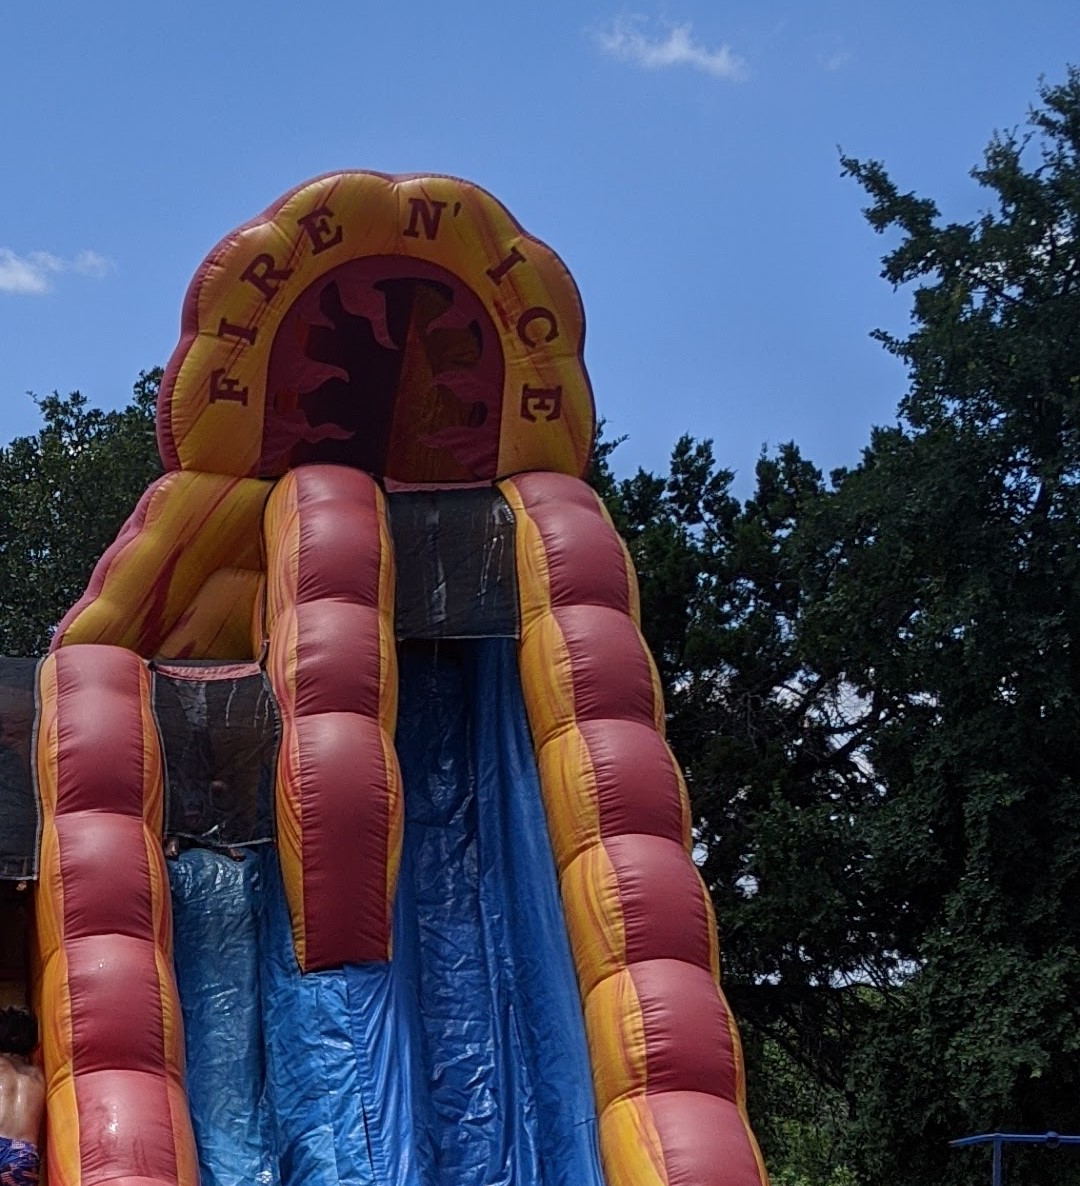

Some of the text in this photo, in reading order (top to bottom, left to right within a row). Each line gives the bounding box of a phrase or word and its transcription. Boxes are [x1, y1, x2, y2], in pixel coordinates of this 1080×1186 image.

[209, 197, 563, 423] FIRE N' ICE
